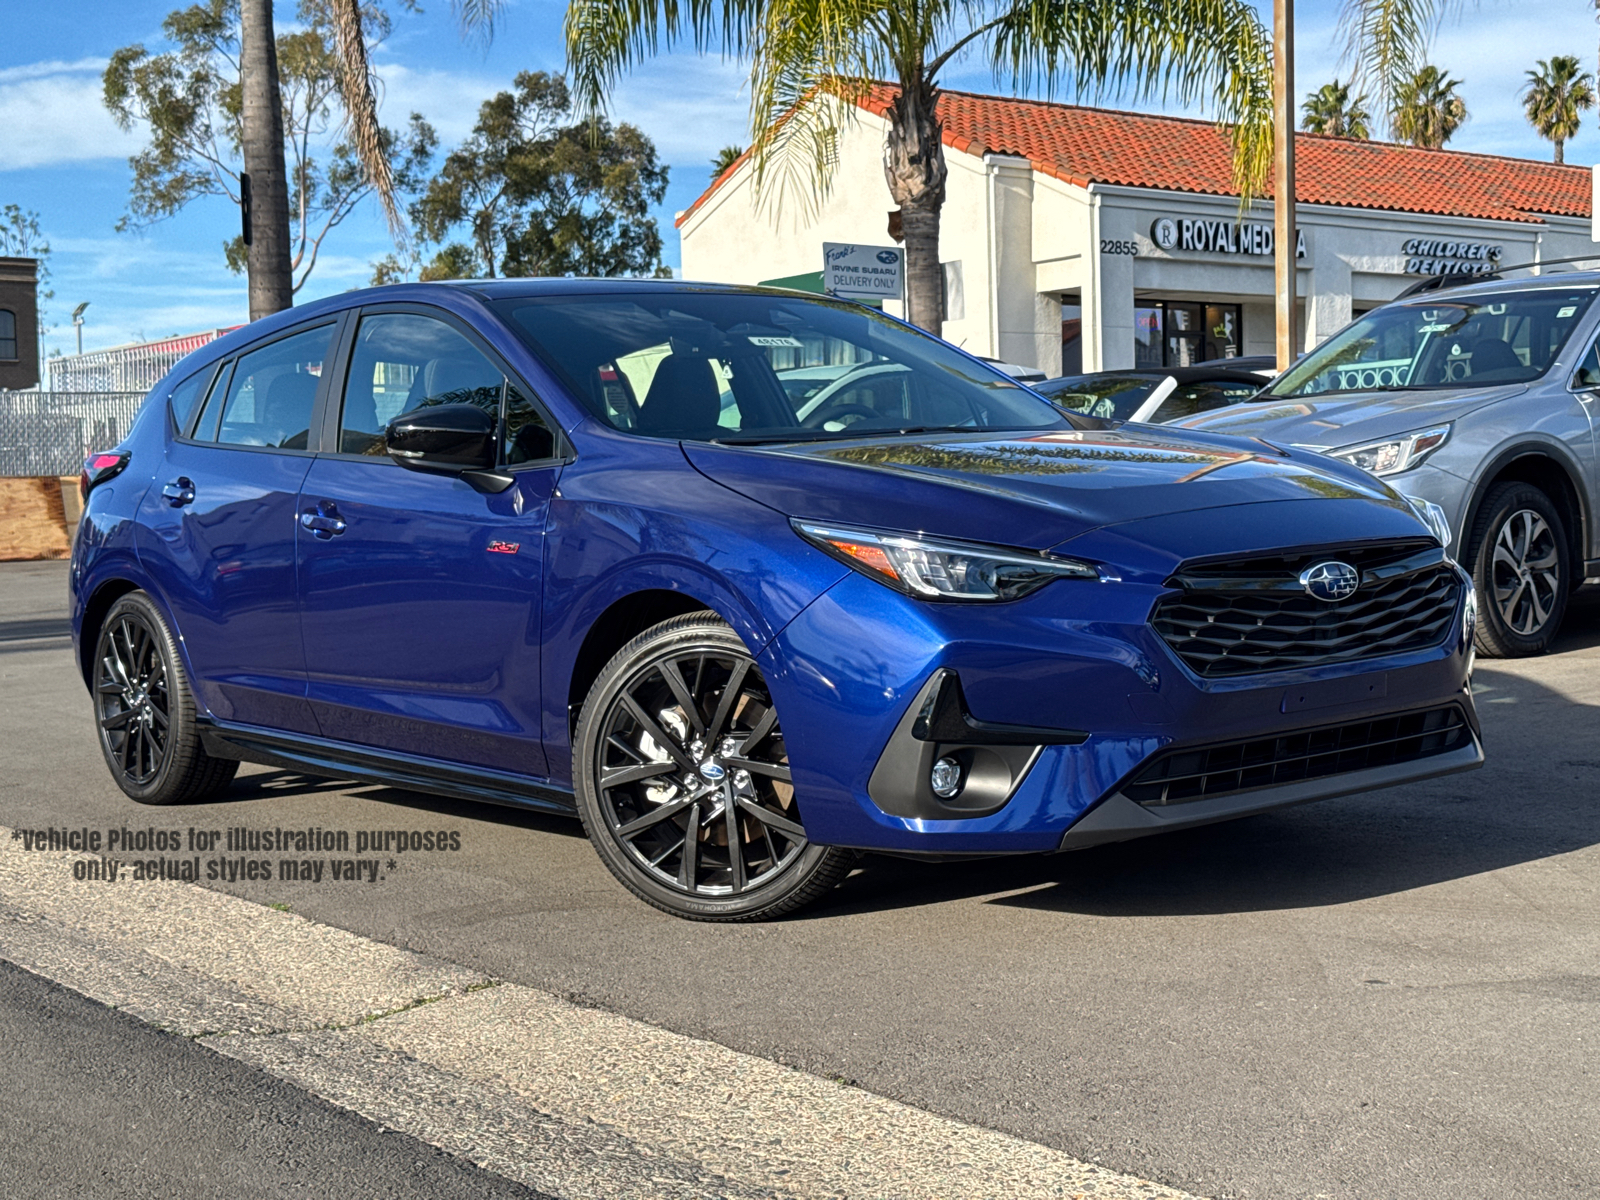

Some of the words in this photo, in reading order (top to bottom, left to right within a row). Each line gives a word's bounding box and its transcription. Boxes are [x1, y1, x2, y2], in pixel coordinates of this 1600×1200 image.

[1180, 218, 1237, 253] ROYAL
[1239, 223, 1308, 258] MEDA
[1100, 239, 1139, 257] 22855
[1403, 239, 1503, 261] CHILDREN'S
[832, 264, 860, 274] IRVINE
[861, 266, 897, 276] SUBARU
[1404, 258, 1499, 276] DENTISTR
[833, 275, 873, 288] DELIVERY
[873, 277, 895, 289] ONLY
[1137, 317, 1159, 328] OPEN
[685, 901, 734, 912] YOKOHAMA
